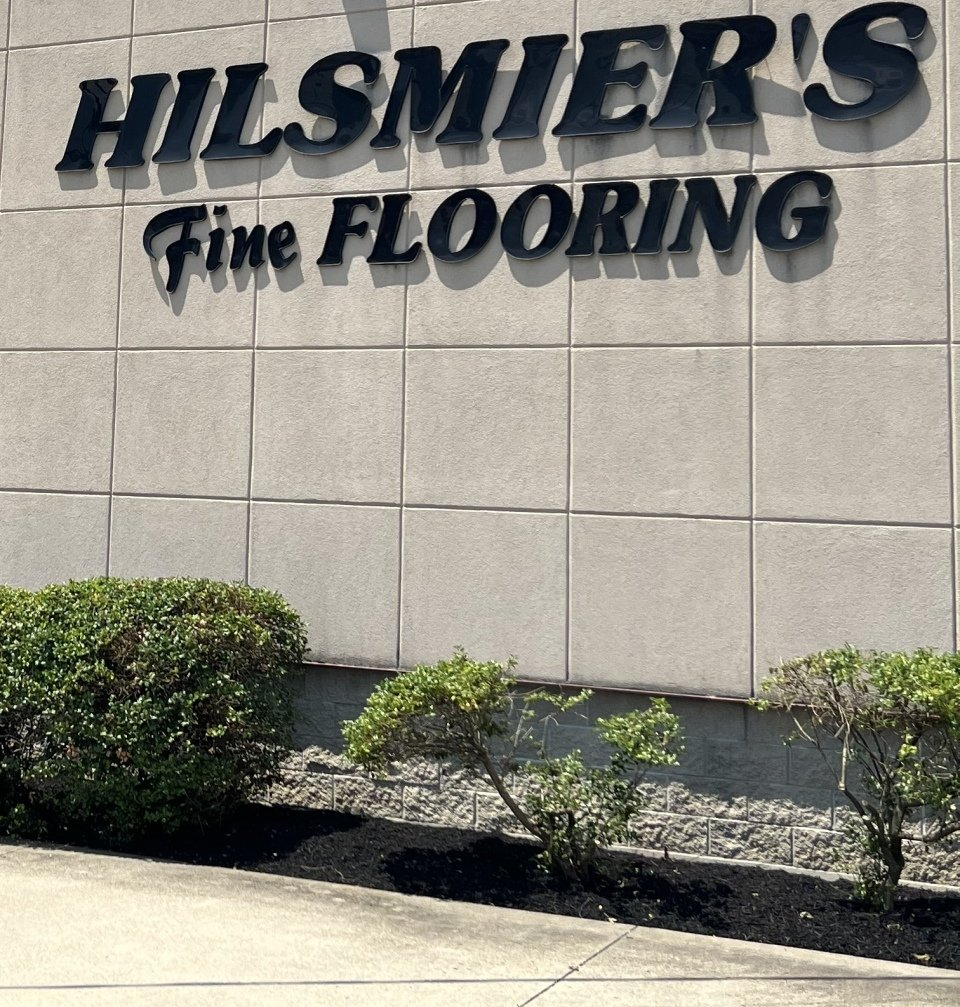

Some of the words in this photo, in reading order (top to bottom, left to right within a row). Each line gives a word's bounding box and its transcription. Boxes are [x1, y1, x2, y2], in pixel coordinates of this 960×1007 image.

[55, 1, 928, 173] HILSMIER'S
[143, 204, 298, 294] Fine
[317, 170, 833, 267] FLOORING
